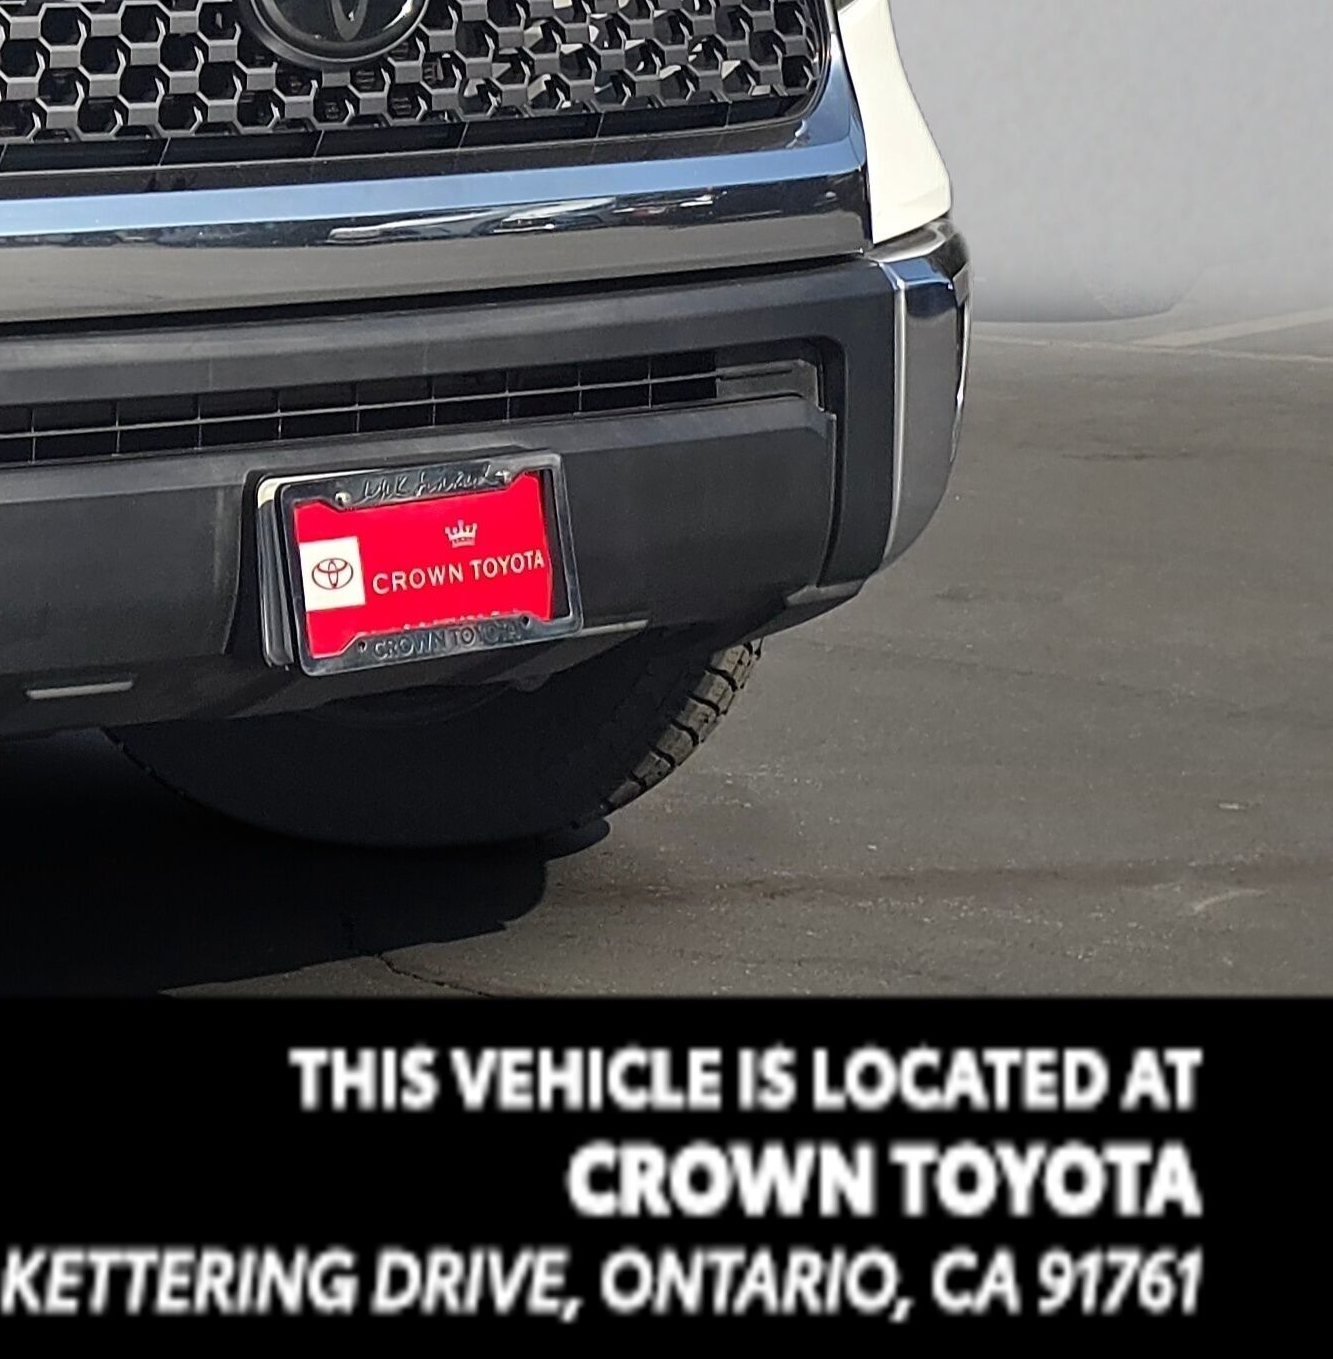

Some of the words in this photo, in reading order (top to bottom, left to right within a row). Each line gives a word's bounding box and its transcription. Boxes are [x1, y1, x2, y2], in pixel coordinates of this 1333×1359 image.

[372, 564, 464, 595] CROWN
[469, 549, 546, 581] TOYOTA
[374, 628, 446, 660] CROWN
[450, 612, 523, 647] TOYOTA
